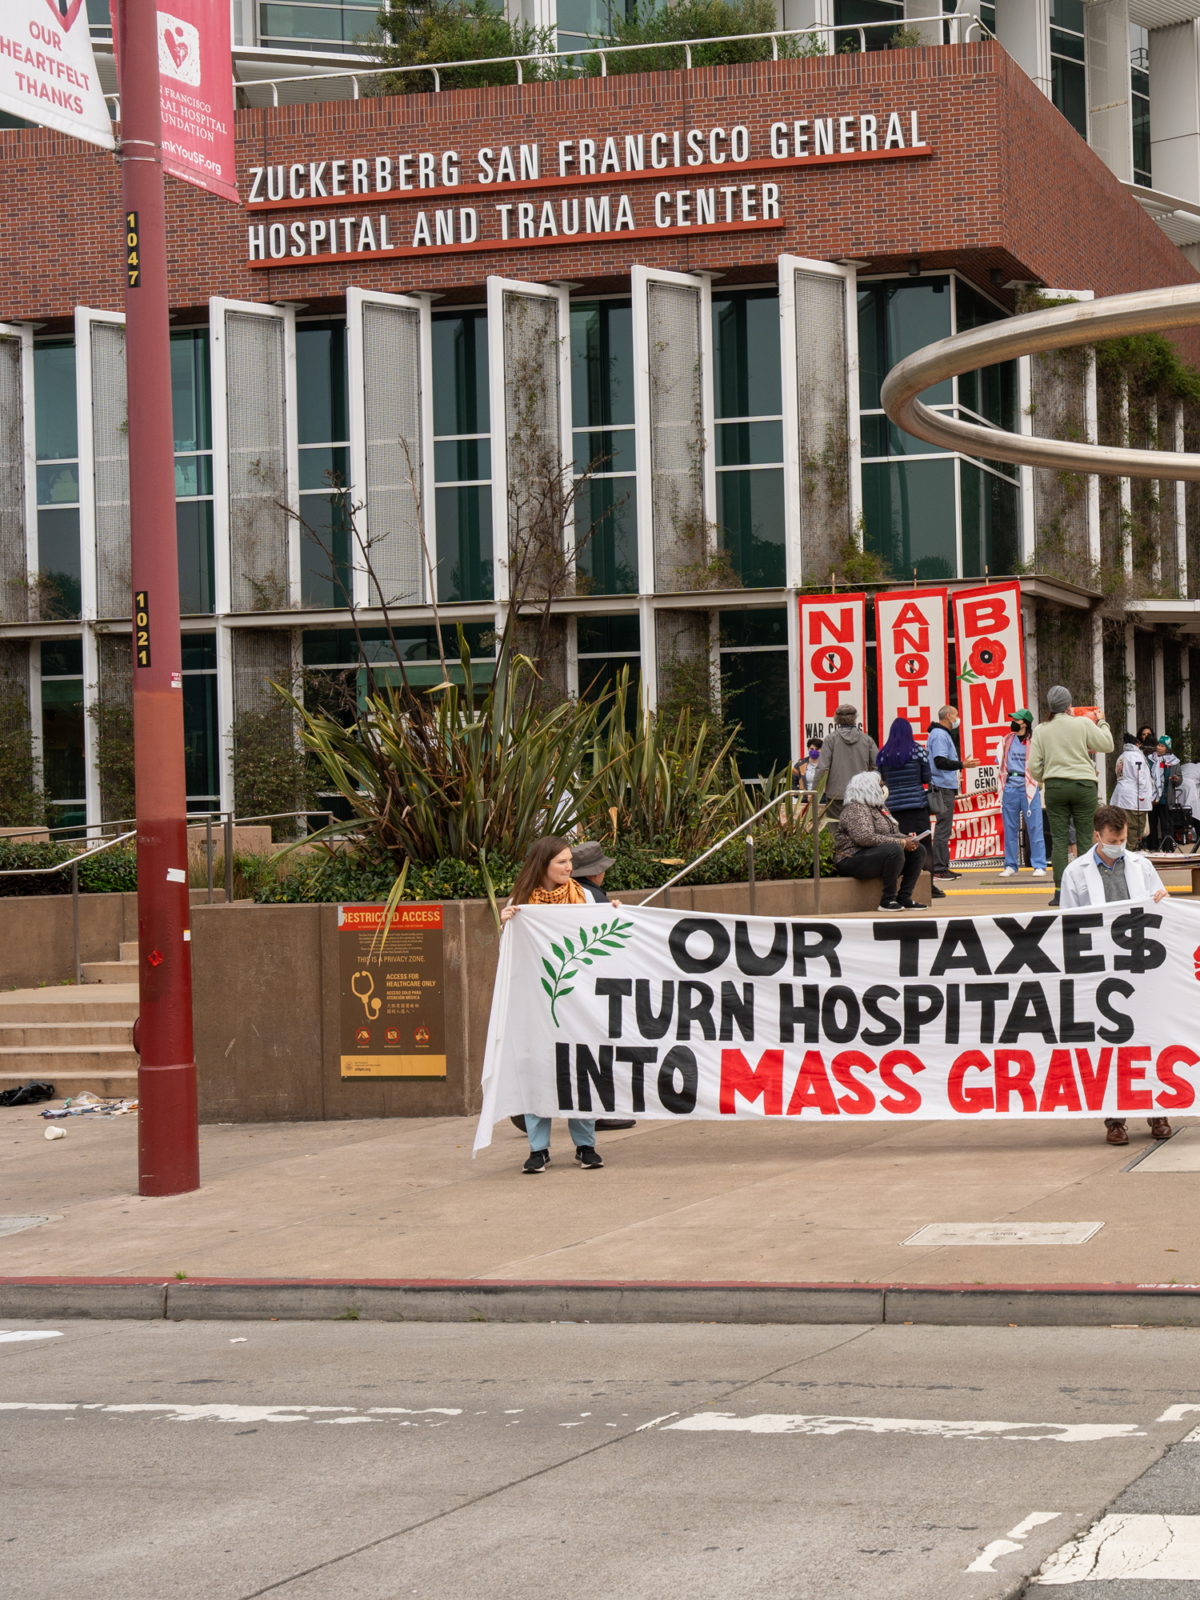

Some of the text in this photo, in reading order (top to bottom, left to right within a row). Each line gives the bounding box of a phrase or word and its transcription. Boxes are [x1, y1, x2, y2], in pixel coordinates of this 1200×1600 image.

[29, 20, 62, 51] OUR
[0, 35, 90, 91] HEARTFELT
[15, 71, 84, 114] THANKS
[165, 87, 211, 113] FRANCISCO
[160, 111, 214, 142] UNDATION
[180, 105, 228, 134] HOSPITAL
[249, 110, 926, 203] ZUCKERBERG SAN FRANCISCO GENERAL
[249, 183, 780, 261] HOSPITAL AND TRAUMA CENTER
[126, 213, 139, 286] 1047
[136, 592, 150, 666] 1021
[809, 608, 854, 717] NOT
[891, 602, 931, 748] ANOTH
[804, 723, 824, 738] WAR
[978, 767, 994, 778] END
[956, 797, 973, 812] IN
[955, 835, 1004, 859] RUBBL
[343, 911, 440, 923] RESTRICTD ACCESS
[668, 906, 1167, 978] OUR TAXE$
[595, 977, 1135, 1046] TURN HOSPITALS
[555, 1042, 698, 1115] INTO
[719, 1048, 927, 1116] MASS
